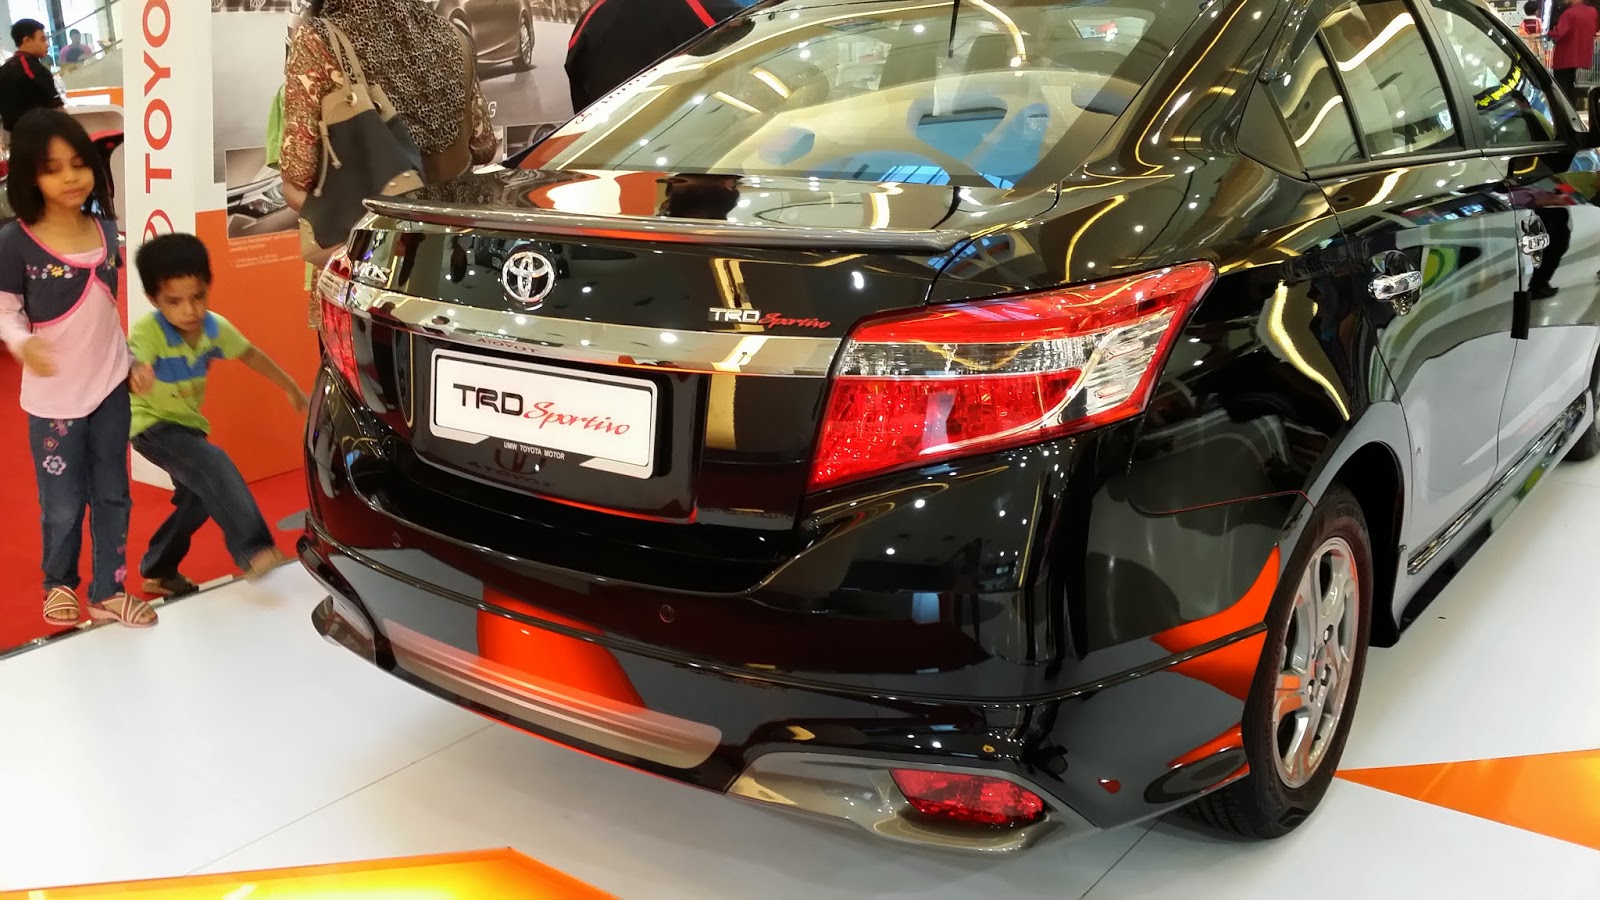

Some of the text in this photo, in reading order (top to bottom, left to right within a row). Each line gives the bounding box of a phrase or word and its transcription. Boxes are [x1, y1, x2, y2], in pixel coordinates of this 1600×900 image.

[709, 307, 831, 329] TRD Sportivo
[452, 382, 630, 435] TRD Sportivo
[503, 441, 565, 461] UMW TOYOTA MOTOR
